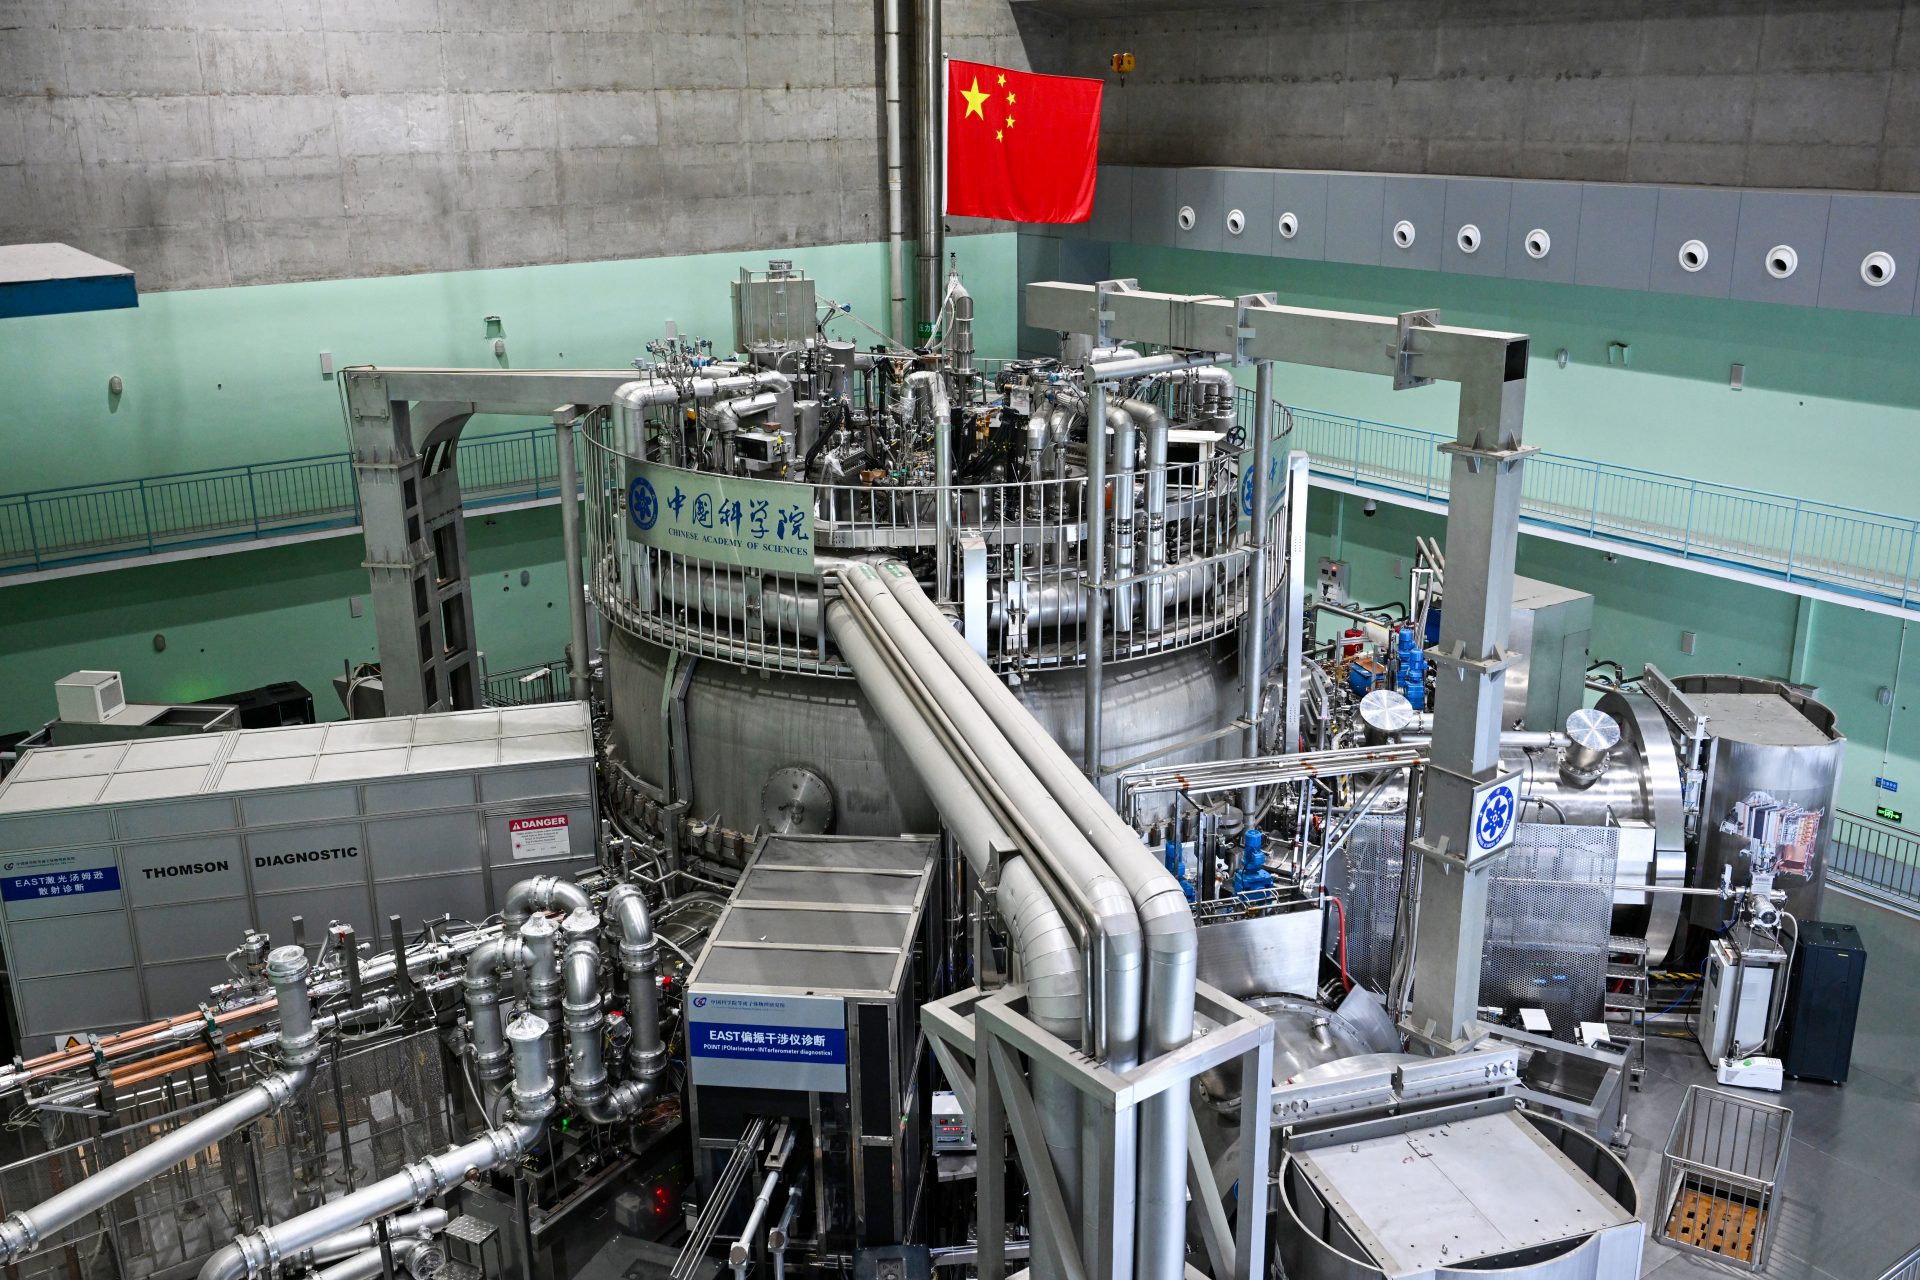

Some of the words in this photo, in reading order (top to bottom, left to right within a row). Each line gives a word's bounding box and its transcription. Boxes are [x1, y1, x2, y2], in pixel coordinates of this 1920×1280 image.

[668, 527, 699, 541] CHINESE
[702, 534, 742, 548] ACADEMY
[747, 542, 759, 550] OF
[762, 543, 808, 556] SCIENCES
[522, 817, 566, 828] DANGER
[142, 860, 229, 879] THOMSON
[255, 847, 358, 868] DIAGNOSTIC
[38, 883, 85, 896] 散射诊断
[709, 1030, 826, 1047] EAST偏振干涉仪诊断
